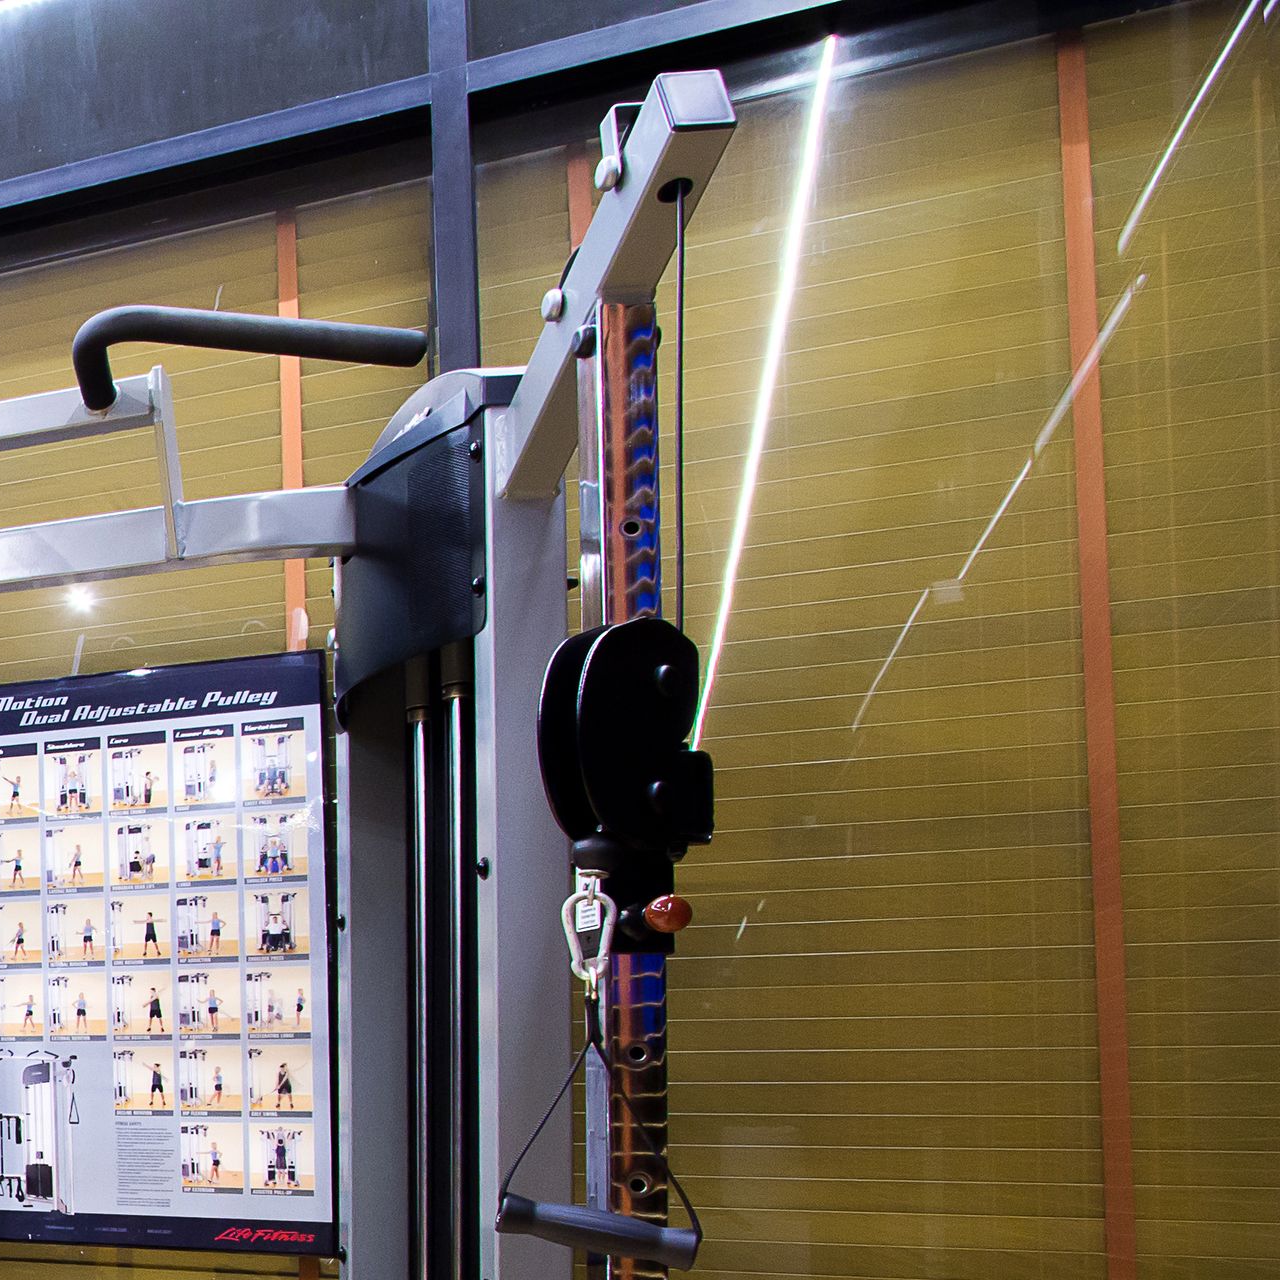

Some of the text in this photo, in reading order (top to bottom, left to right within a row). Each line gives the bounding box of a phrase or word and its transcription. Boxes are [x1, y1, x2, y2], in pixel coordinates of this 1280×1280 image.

[19, 689, 278, 727] Dual Adjustable Pulley
